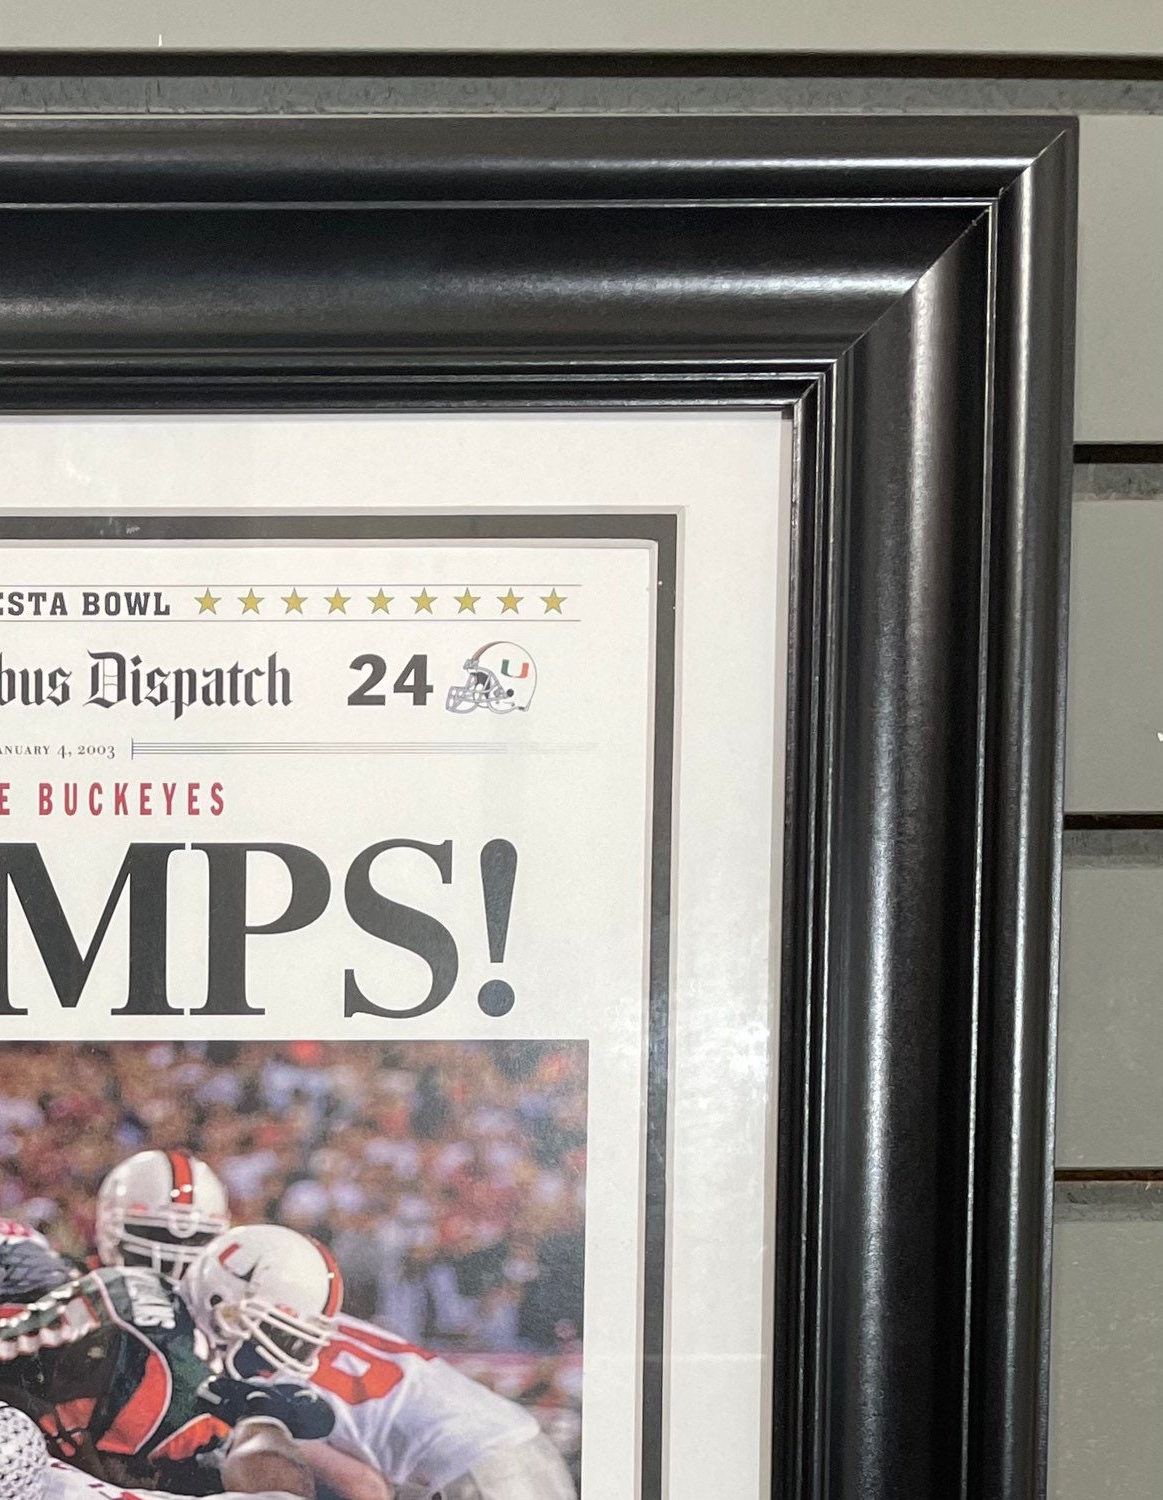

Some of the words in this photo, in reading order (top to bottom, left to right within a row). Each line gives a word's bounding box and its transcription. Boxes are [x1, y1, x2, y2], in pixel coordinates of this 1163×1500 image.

[82, 592, 170, 616] BOWL
[83, 651, 292, 720] Dispatch
[348, 654, 433, 706] 24
[57, 744, 73, 760] 4,
[77, 745, 116, 760] 2003
[39, 782, 223, 816] BUCKEYES
